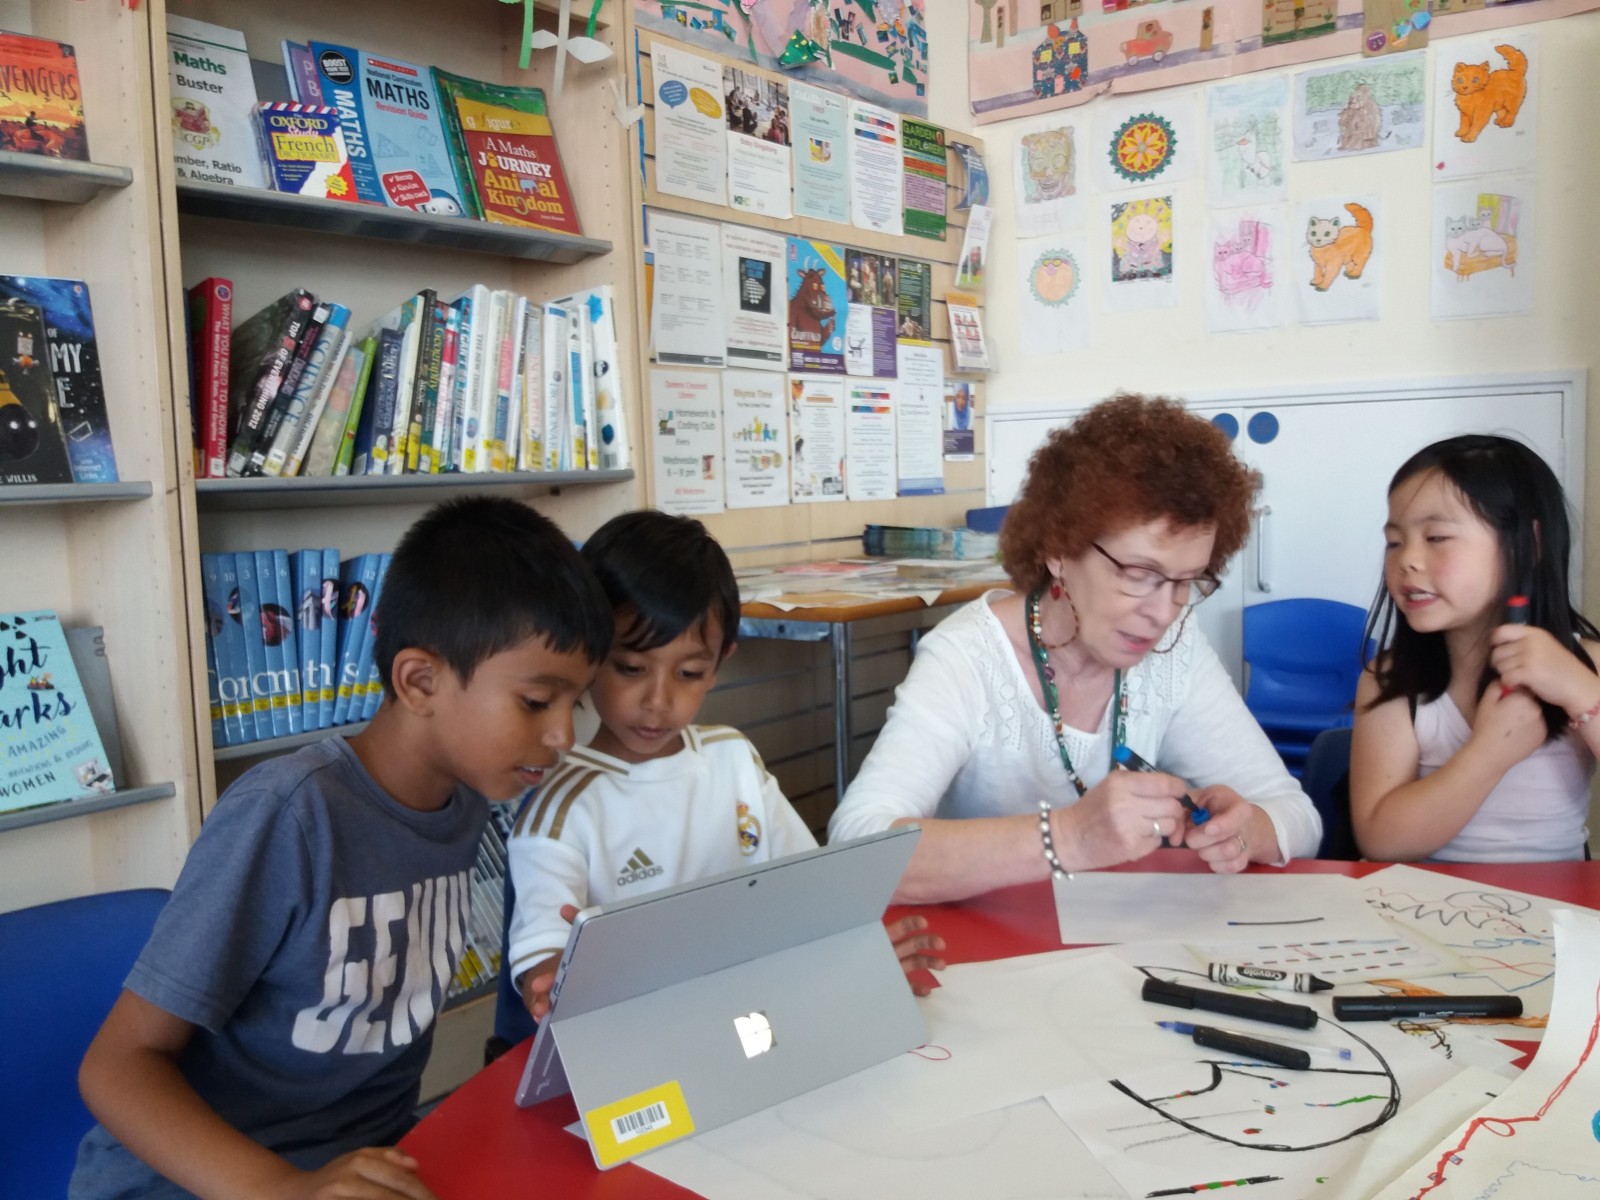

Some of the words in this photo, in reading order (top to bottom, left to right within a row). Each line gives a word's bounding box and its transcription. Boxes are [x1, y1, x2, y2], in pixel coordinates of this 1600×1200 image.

[173, 51, 227, 75] Maths
[322, 59, 346, 67] BOOST
[0, 64, 78, 101] VENGERS
[176, 74, 223, 94] Buster
[366, 77, 430, 110] MATHS
[376, 101, 407, 115] Revision
[408, 109, 428, 120] Guide
[269, 116, 328, 129] OXFORD
[287, 126, 319, 139] Study
[333, 89, 367, 158] MATHS
[184, 133, 209, 145] CGP
[275, 135, 335, 153] French
[486, 137, 496, 150] A
[498, 139, 537, 159] Maths
[177, 167, 186, 177] &
[212, 160, 242, 173] Ratio
[487, 188, 564, 215] Kingdom
[221, 303, 230, 330] WHAT
[289, 320, 301, 338] TOP
[221, 336, 230, 356] YOU
[277, 347, 289, 359] OF
[51, 343, 82, 373] MY
[428, 326, 444, 391] Geography
[220, 358, 229, 386] NEED
[286, 338, 332, 425] SCIENCE
[56, 377, 75, 409] E
[219, 388, 228, 403] TO
[218, 404, 227, 438] KNOW
[248, 408, 263, 430] 2012
[6, 474, 38, 483] WILLIS
[8, 725, 67, 758] AMAZING
[0, 771, 57, 798] WOMEN
[616, 864, 664, 886] adidas
[1243, 968, 1282, 980] Crayola
